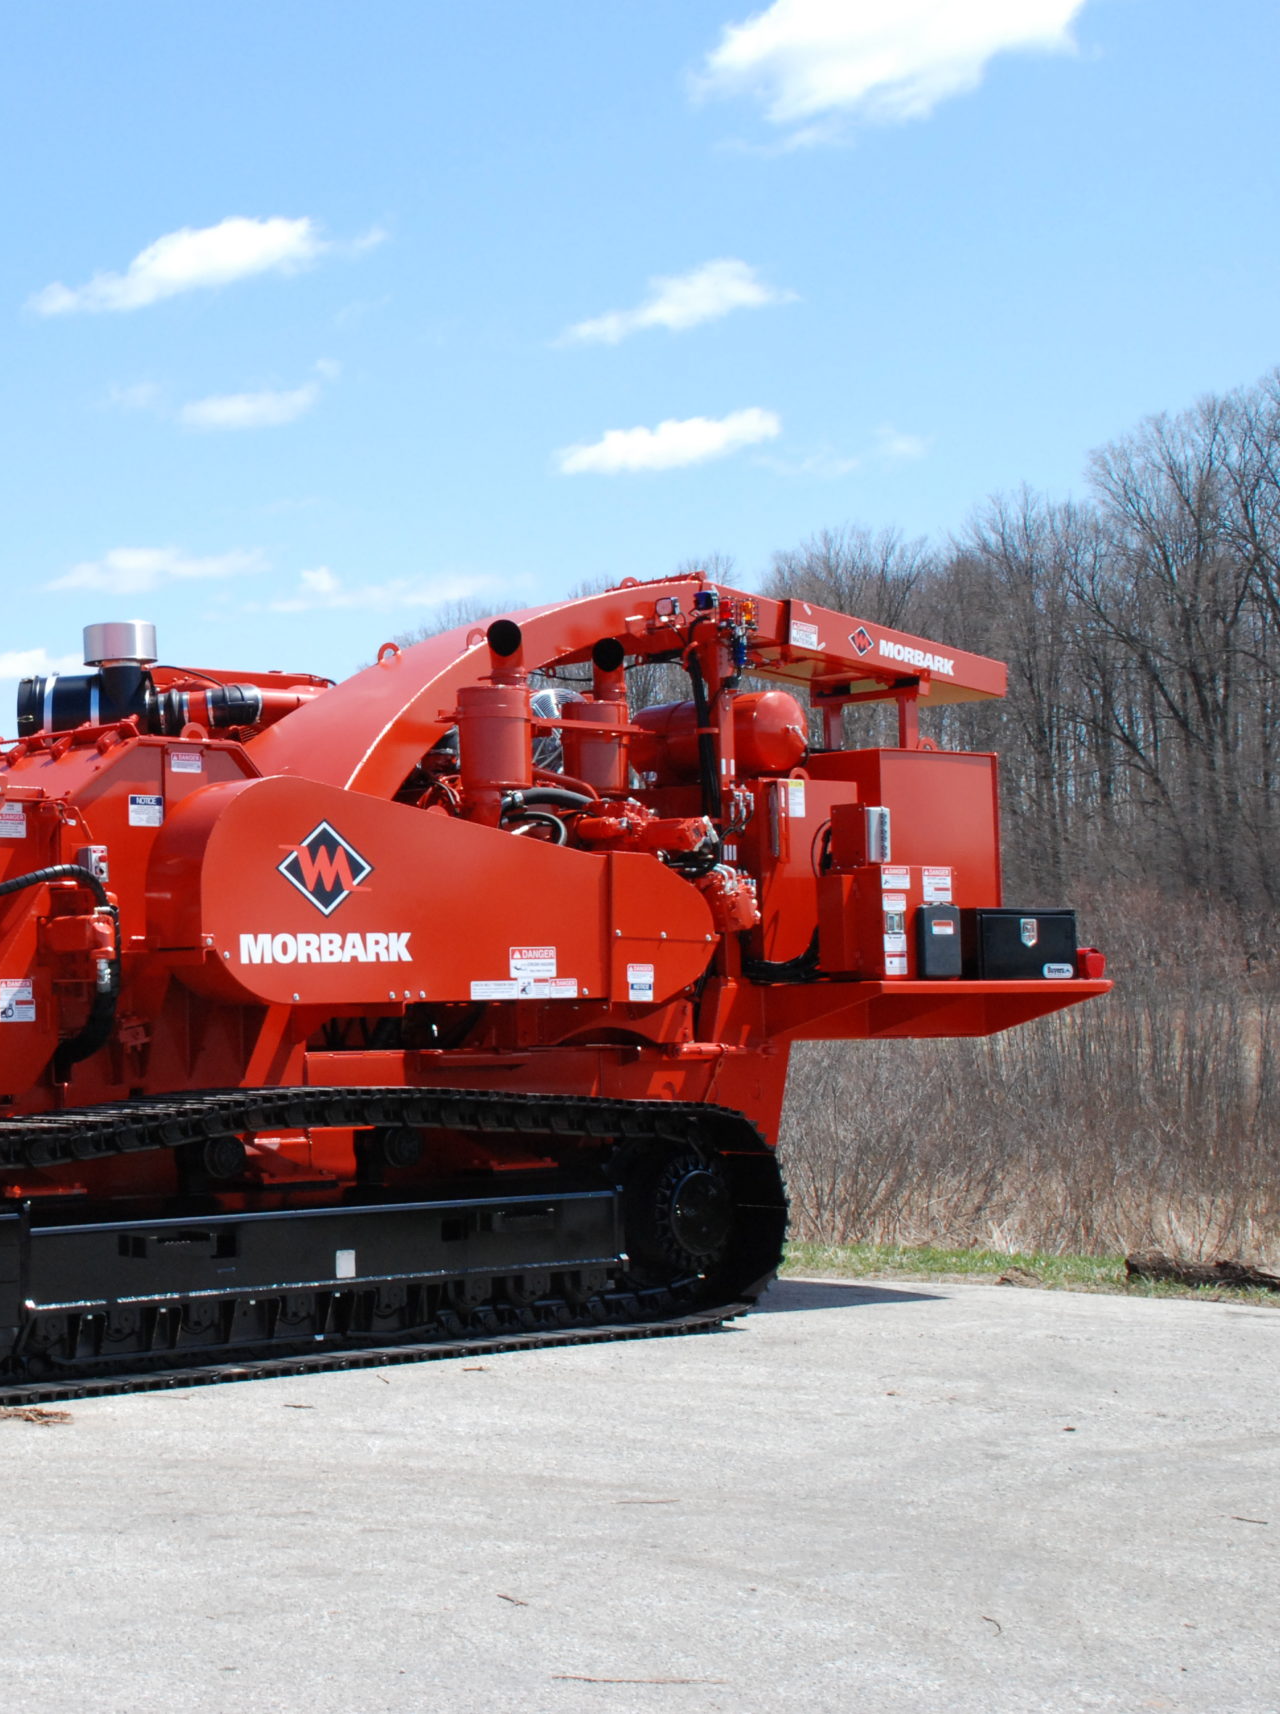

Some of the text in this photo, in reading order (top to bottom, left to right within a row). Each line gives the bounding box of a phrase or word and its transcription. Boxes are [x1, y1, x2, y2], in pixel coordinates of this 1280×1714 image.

[879, 639, 955, 676] MORBARK
[136, 796, 158, 805] NOTICE
[239, 932, 413, 964] MORBARK
[521, 949, 555, 959] DANGER
